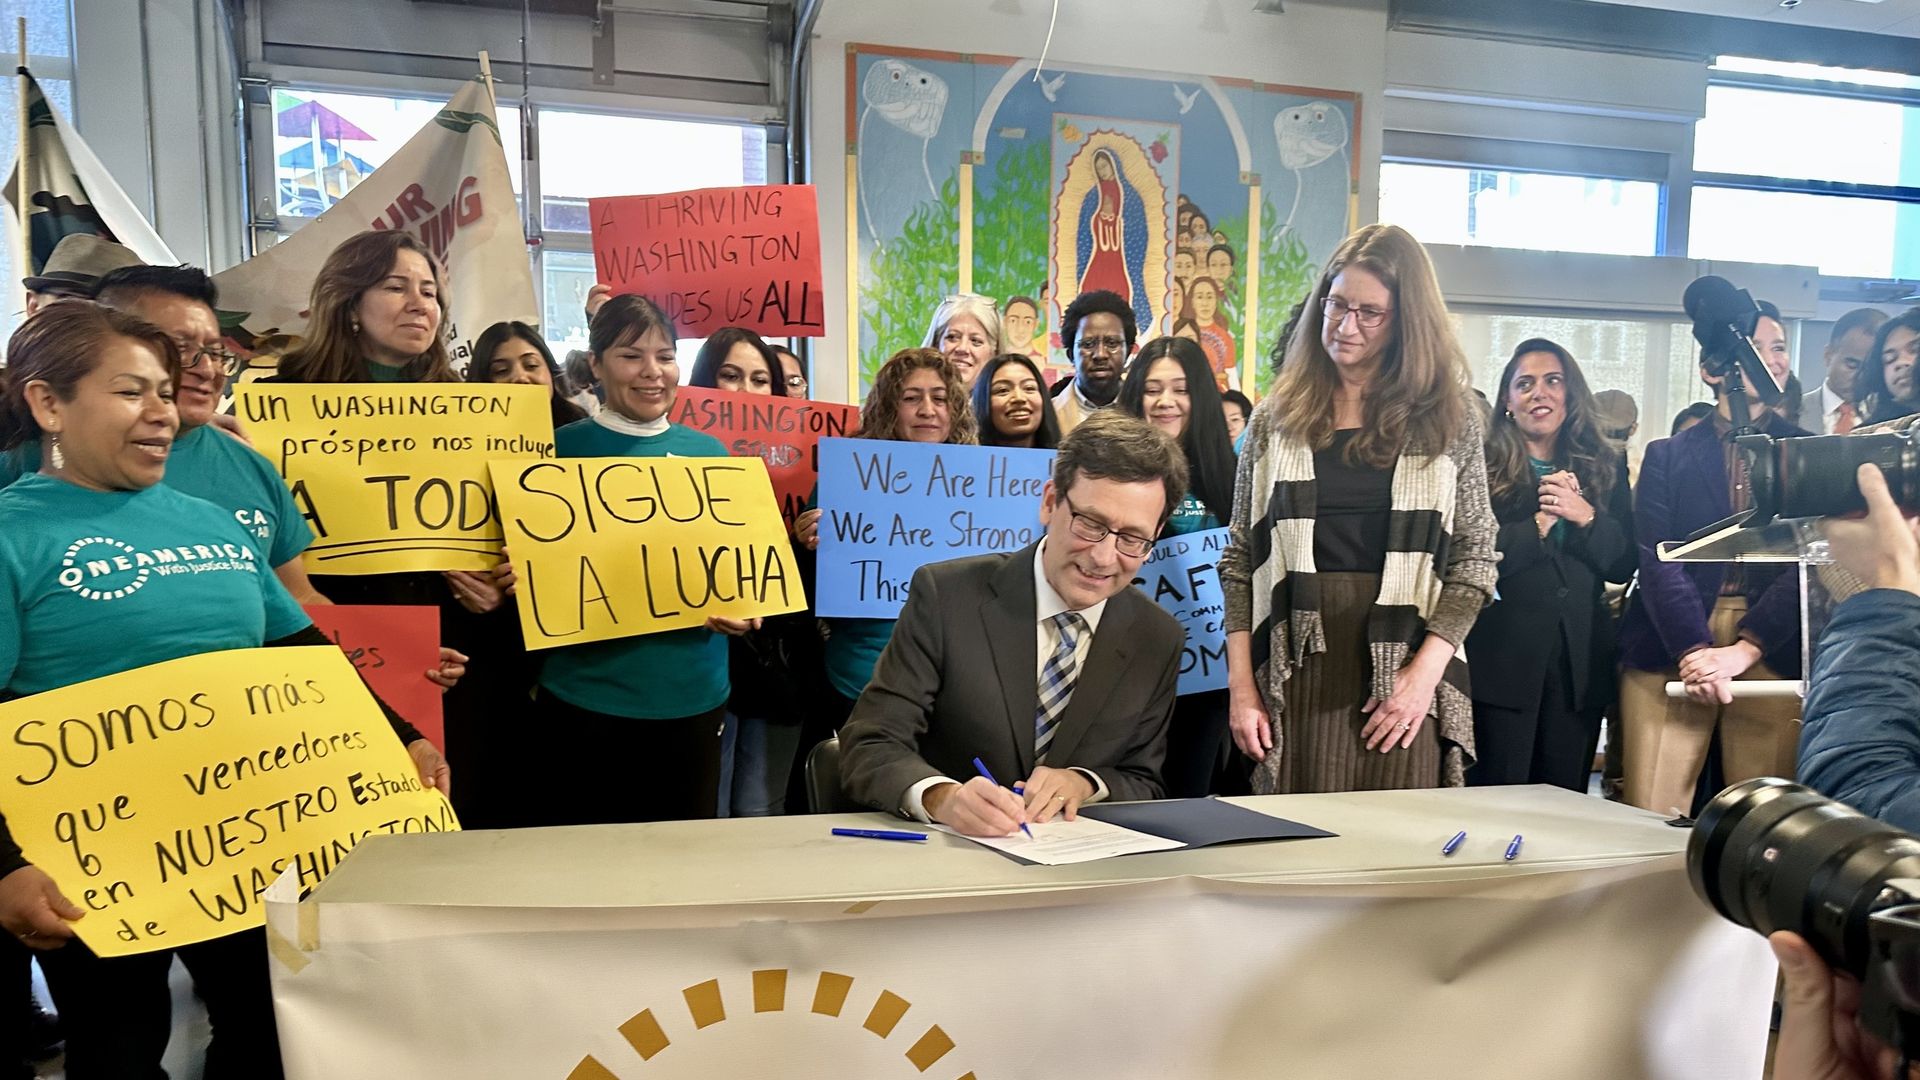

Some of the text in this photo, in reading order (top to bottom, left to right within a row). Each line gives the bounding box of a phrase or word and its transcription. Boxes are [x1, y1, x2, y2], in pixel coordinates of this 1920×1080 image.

[599, 190, 783, 236] A THRIVING
[602, 231, 801, 285] WASHINGTON
[726, 288, 753, 323] US
[757, 280, 821, 327] ALL
[312, 394, 512, 420] WASHINGTON
[667, 396, 848, 437] ASHINGTON
[282, 430, 555, 479] próspero nos incluye
[853, 451, 913, 494] We
[926, 454, 976, 498] Are
[516, 463, 747, 543] SIGUE
[831, 510, 877, 545] We
[888, 513, 934, 547] Are
[526, 544, 790, 637] LA LUCHA
[851, 560, 910, 603] This
[245, 674, 326, 716] más
[184, 731, 368, 796] vencedores
[55, 795, 136, 877] que
[84, 771, 421, 911] en NUESTRO Estado
[116, 918, 167, 942] de
